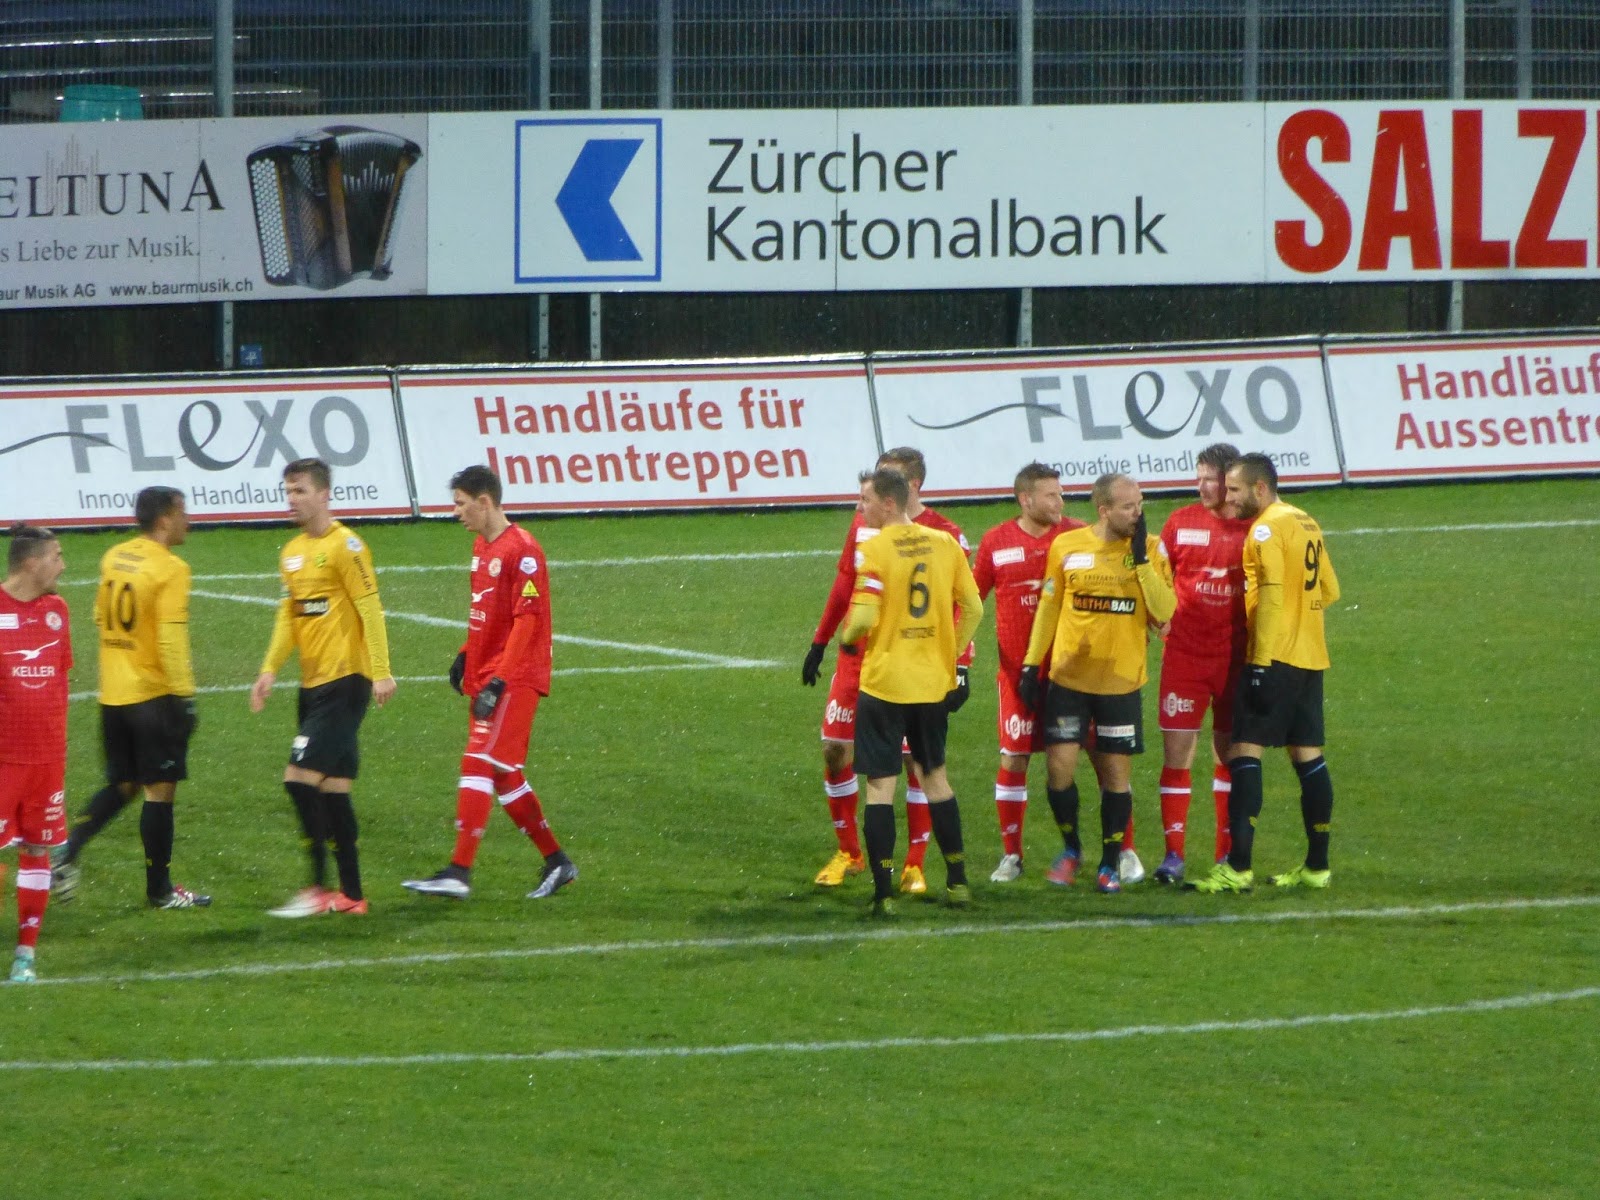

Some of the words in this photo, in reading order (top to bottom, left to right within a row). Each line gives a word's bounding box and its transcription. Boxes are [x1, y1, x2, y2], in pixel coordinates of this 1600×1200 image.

[707, 134, 957, 194] Zürcher
[1275, 109, 1600, 273] SALZ
[18, 240, 77, 261] Liebe
[85, 243, 119, 260] zur
[126, 235, 200, 259] Musik.
[707, 196, 1167, 263] Kantonalbank
[25, 284, 68, 299] Musik
[73, 283, 96, 297] AG
[110, 278, 253, 297] www.baurmusik.ch
[474, 388, 723, 435] Handläufe
[739, 386, 805, 430] für
[1396, 407, 1600, 450] Aussentr
[486, 444, 809, 493] Innentreppen
[105, 580, 138, 632] 10
[909, 563, 929, 619] 6
[12, 665, 55, 677] KELLER
